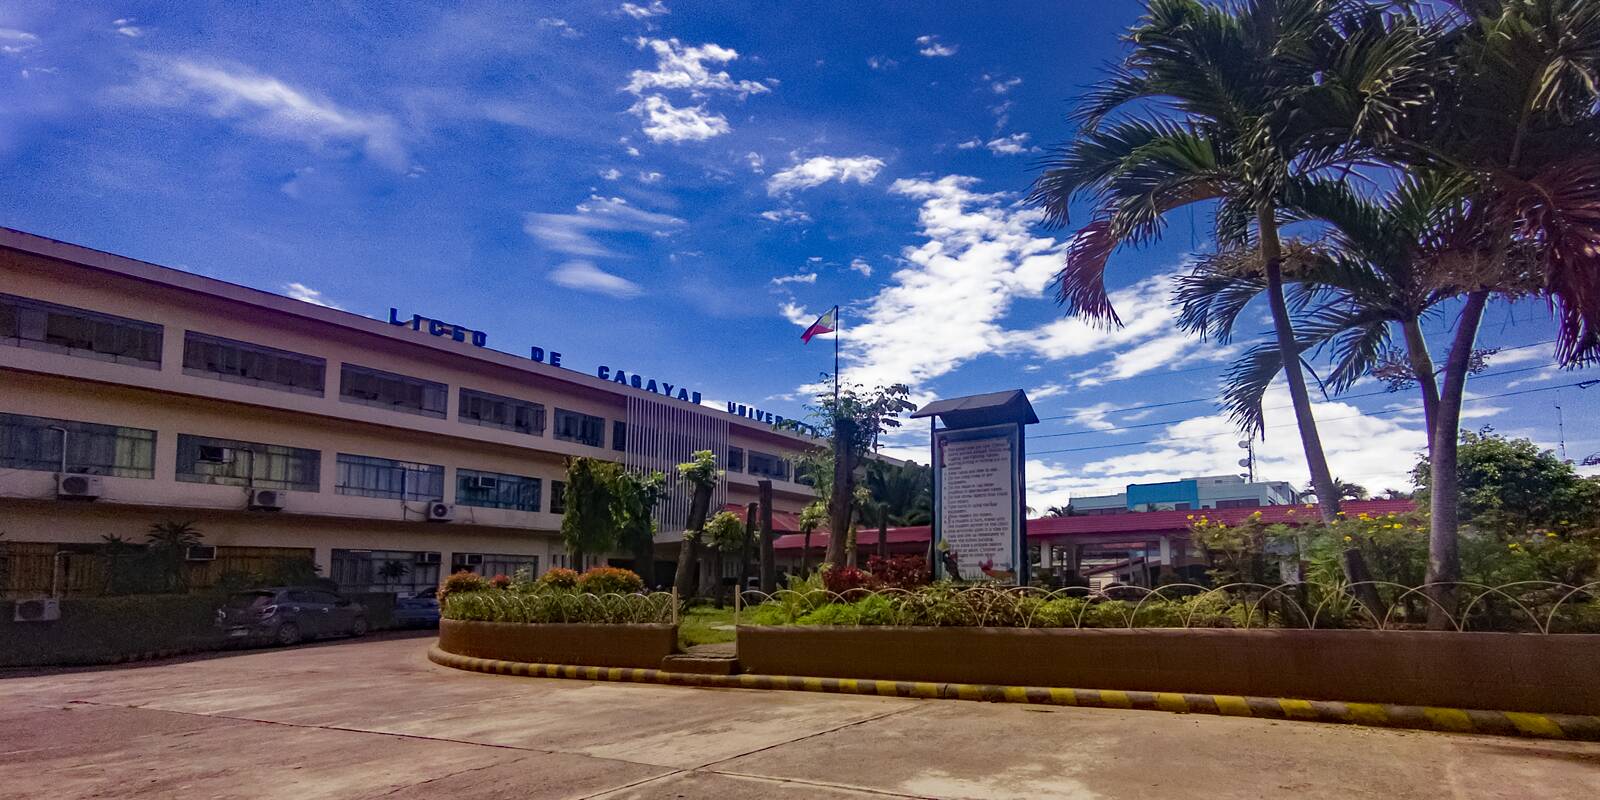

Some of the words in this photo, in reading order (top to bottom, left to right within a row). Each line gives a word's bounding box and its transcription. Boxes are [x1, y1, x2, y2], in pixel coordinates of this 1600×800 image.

[389, 307, 488, 347] LICEO
[531, 346, 562, 368] DE
[598, 365, 702, 405] CAGAYAN
[727, 401, 819, 438] UNIVER
